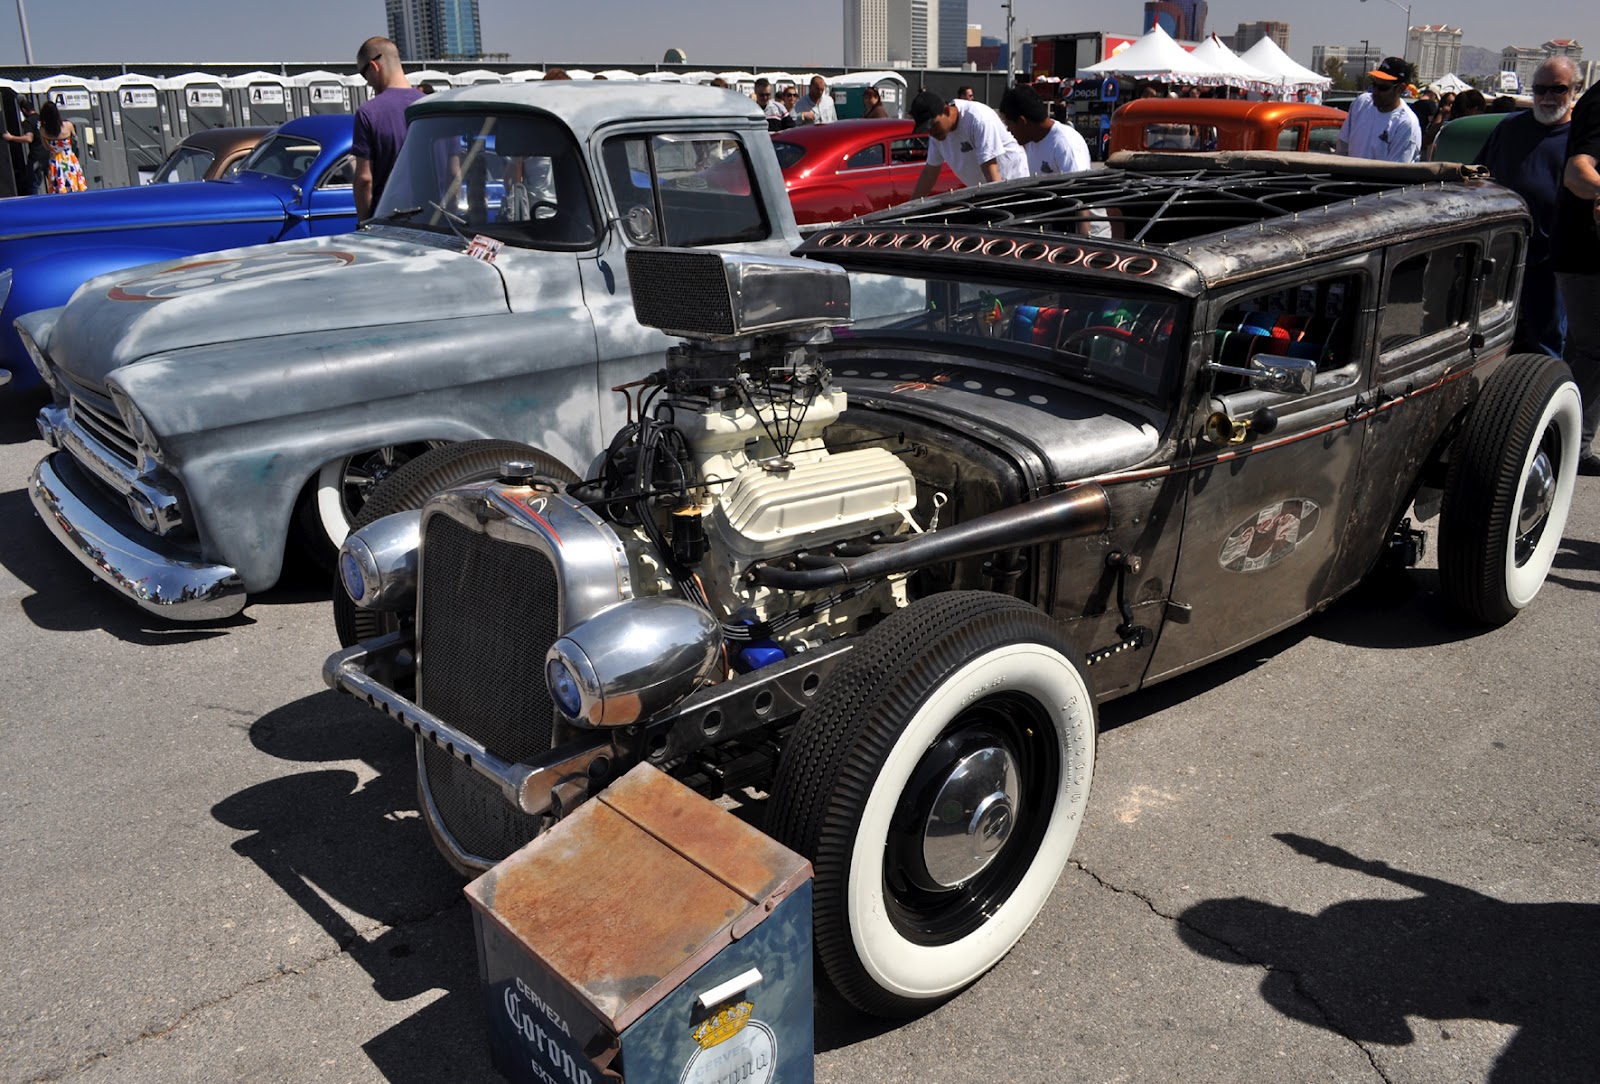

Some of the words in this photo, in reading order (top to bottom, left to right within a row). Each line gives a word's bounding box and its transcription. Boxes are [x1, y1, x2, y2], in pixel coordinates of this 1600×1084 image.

[54, 93, 66, 106] A
[123, 91, 134, 104] A
[190, 91, 200, 103] A
[253, 89, 262, 101] A
[313, 88, 322, 100] A
[1074, 88, 1098, 99] pepsi
[516, 977, 571, 1038] CERVEZA
[504, 987, 592, 1084] Corona
[695, 1034, 760, 1078] CERVE
